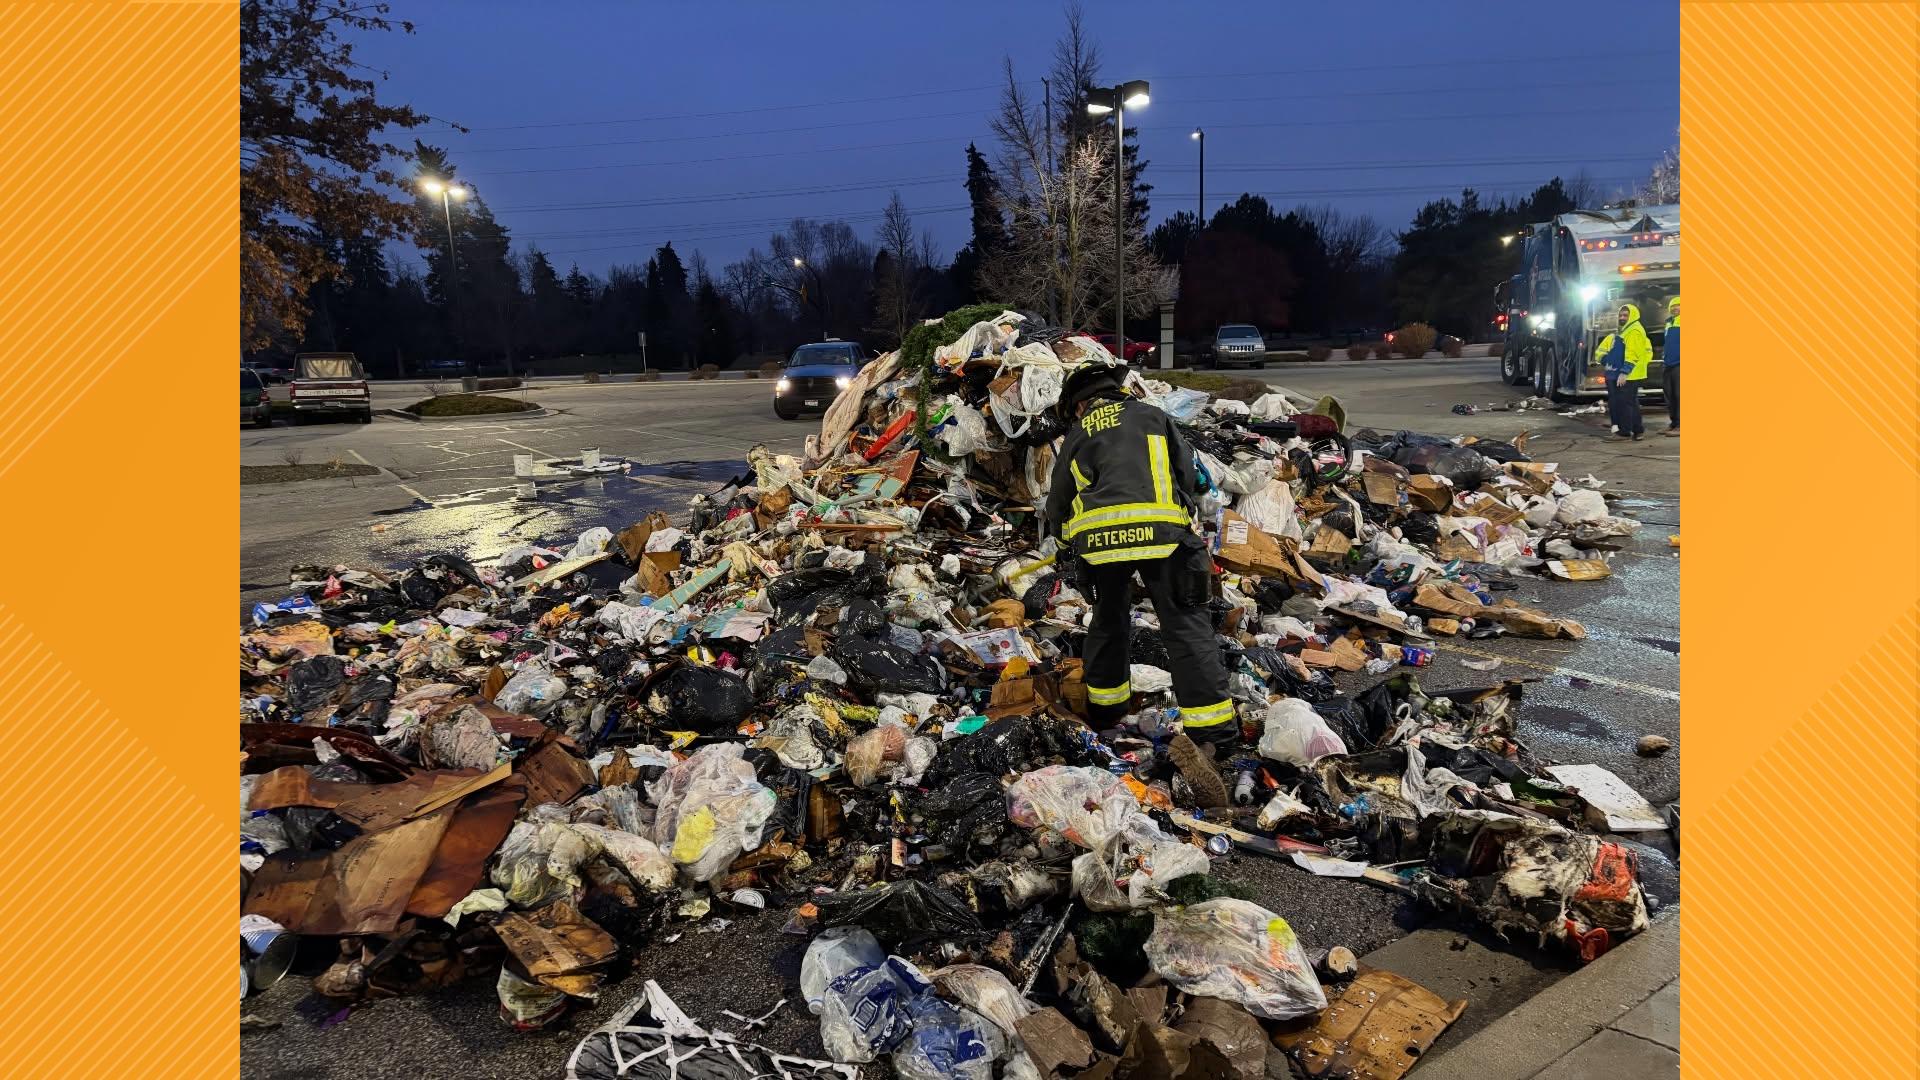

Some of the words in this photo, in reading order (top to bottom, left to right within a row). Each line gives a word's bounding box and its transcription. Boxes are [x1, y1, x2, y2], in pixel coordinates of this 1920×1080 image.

[1081, 402, 1126, 430] BOISE
[1087, 413, 1122, 437] FIRE
[1087, 526, 1154, 548] PETERSON
